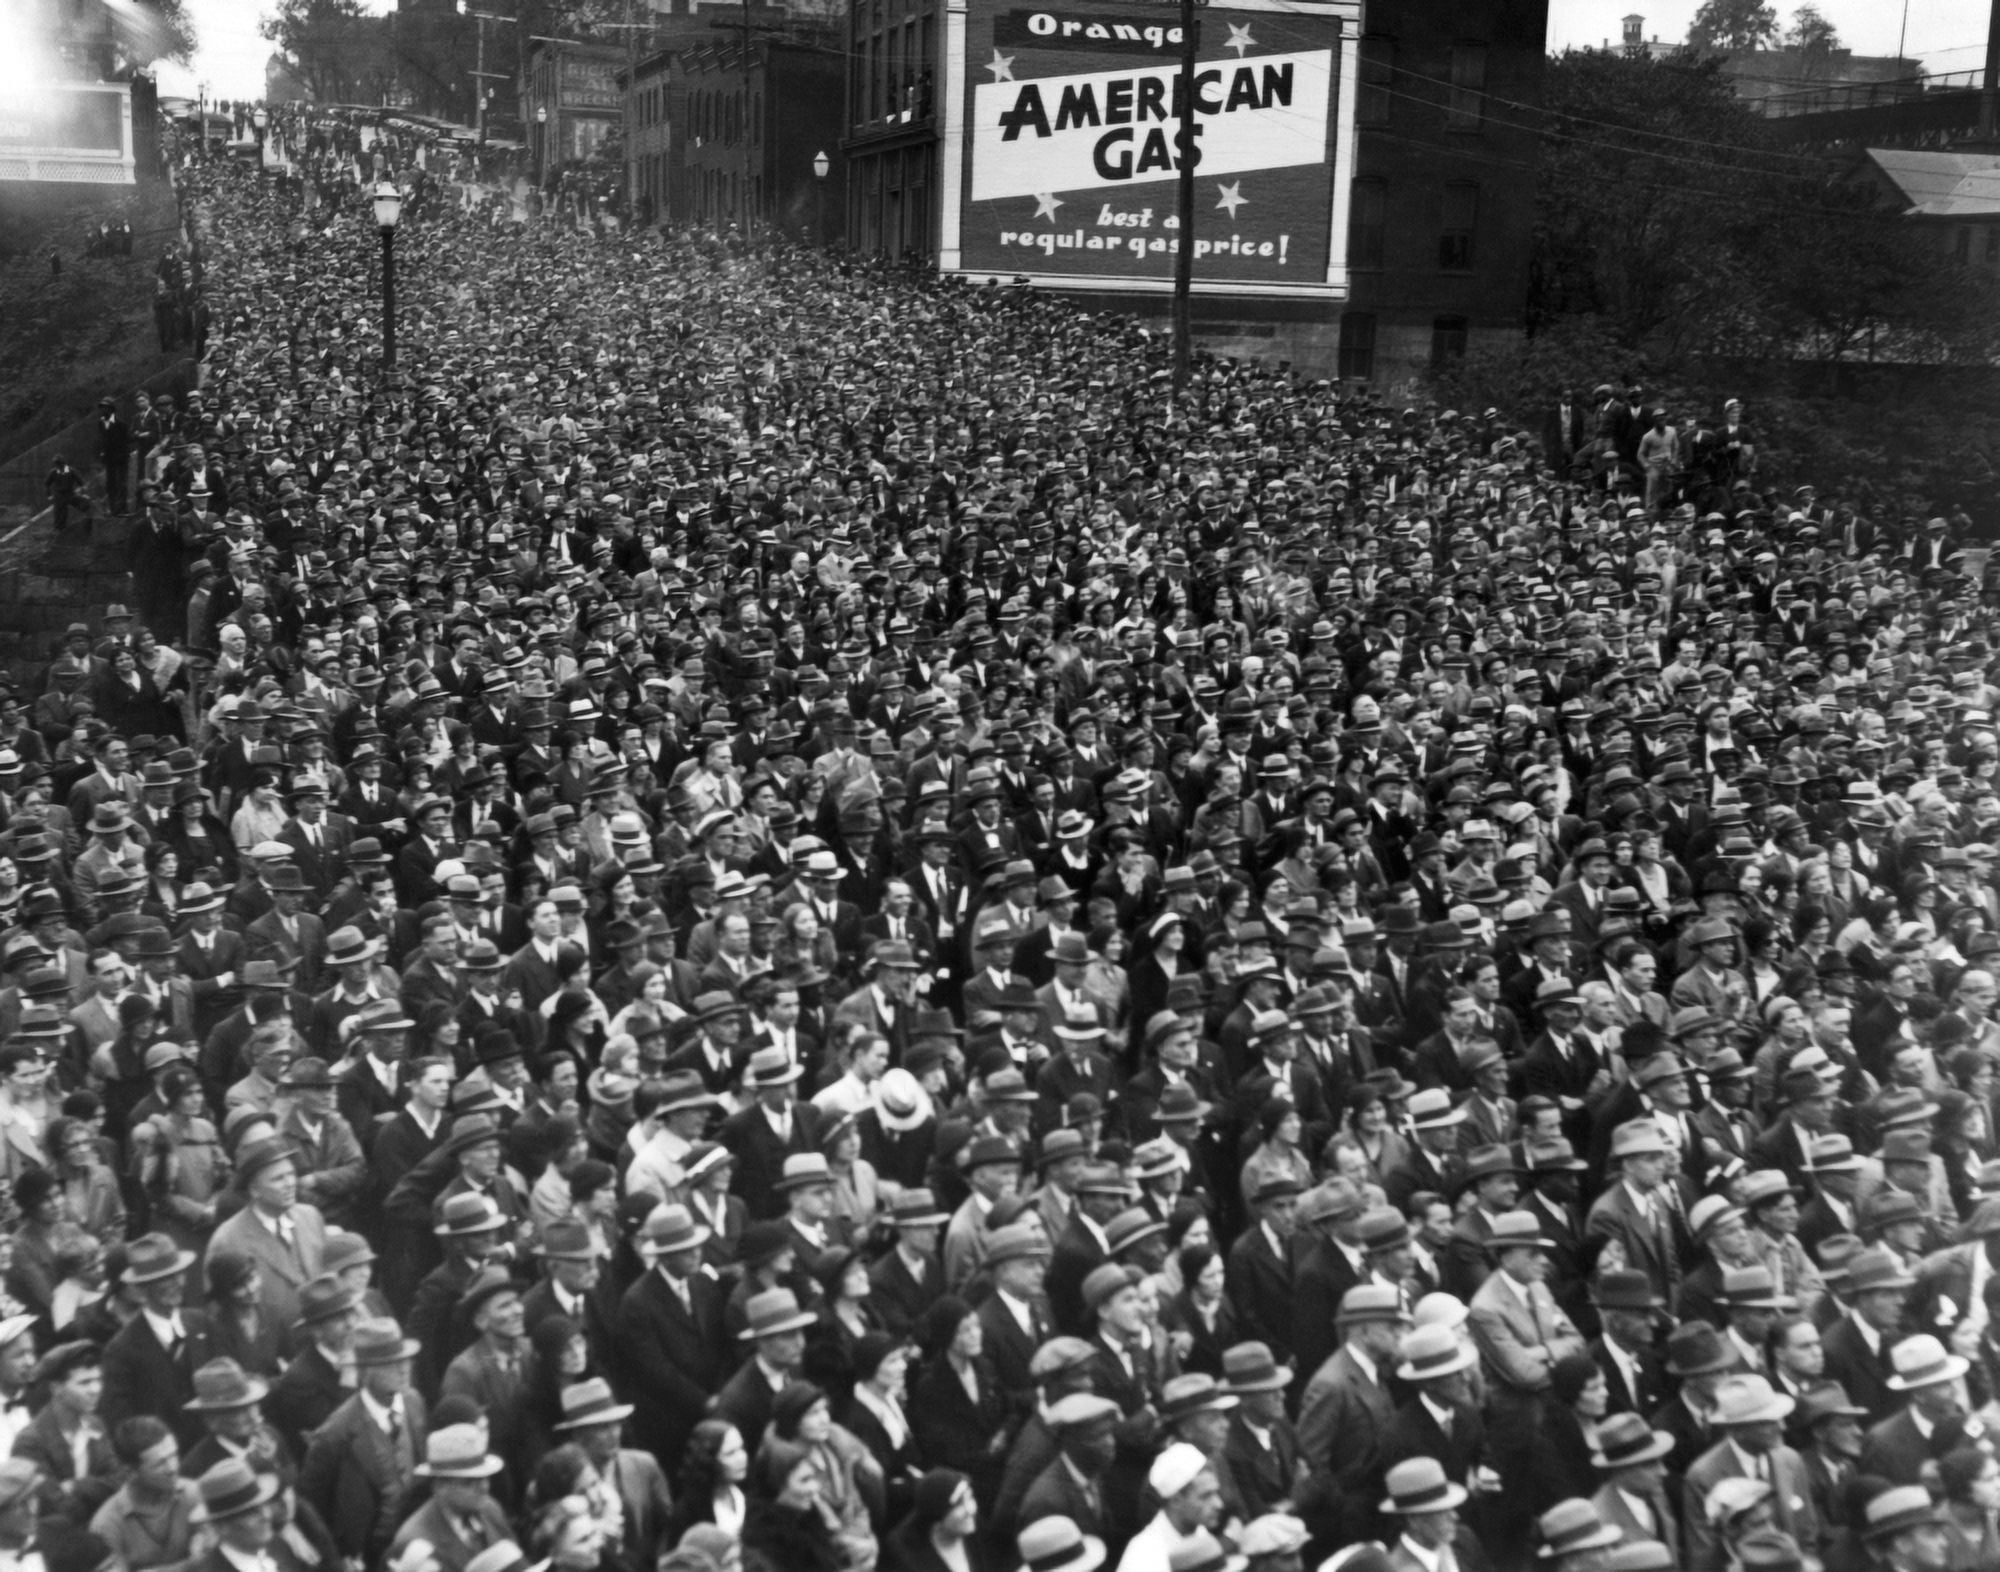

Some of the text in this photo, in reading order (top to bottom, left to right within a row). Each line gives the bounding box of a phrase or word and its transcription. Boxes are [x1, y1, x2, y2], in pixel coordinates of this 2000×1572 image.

[999, 62, 1294, 141] AMERICAN
[1093, 124, 1203, 181] GAS
[1096, 203, 1152, 228] best
[1000, 229, 1289, 264] regular gas price!
